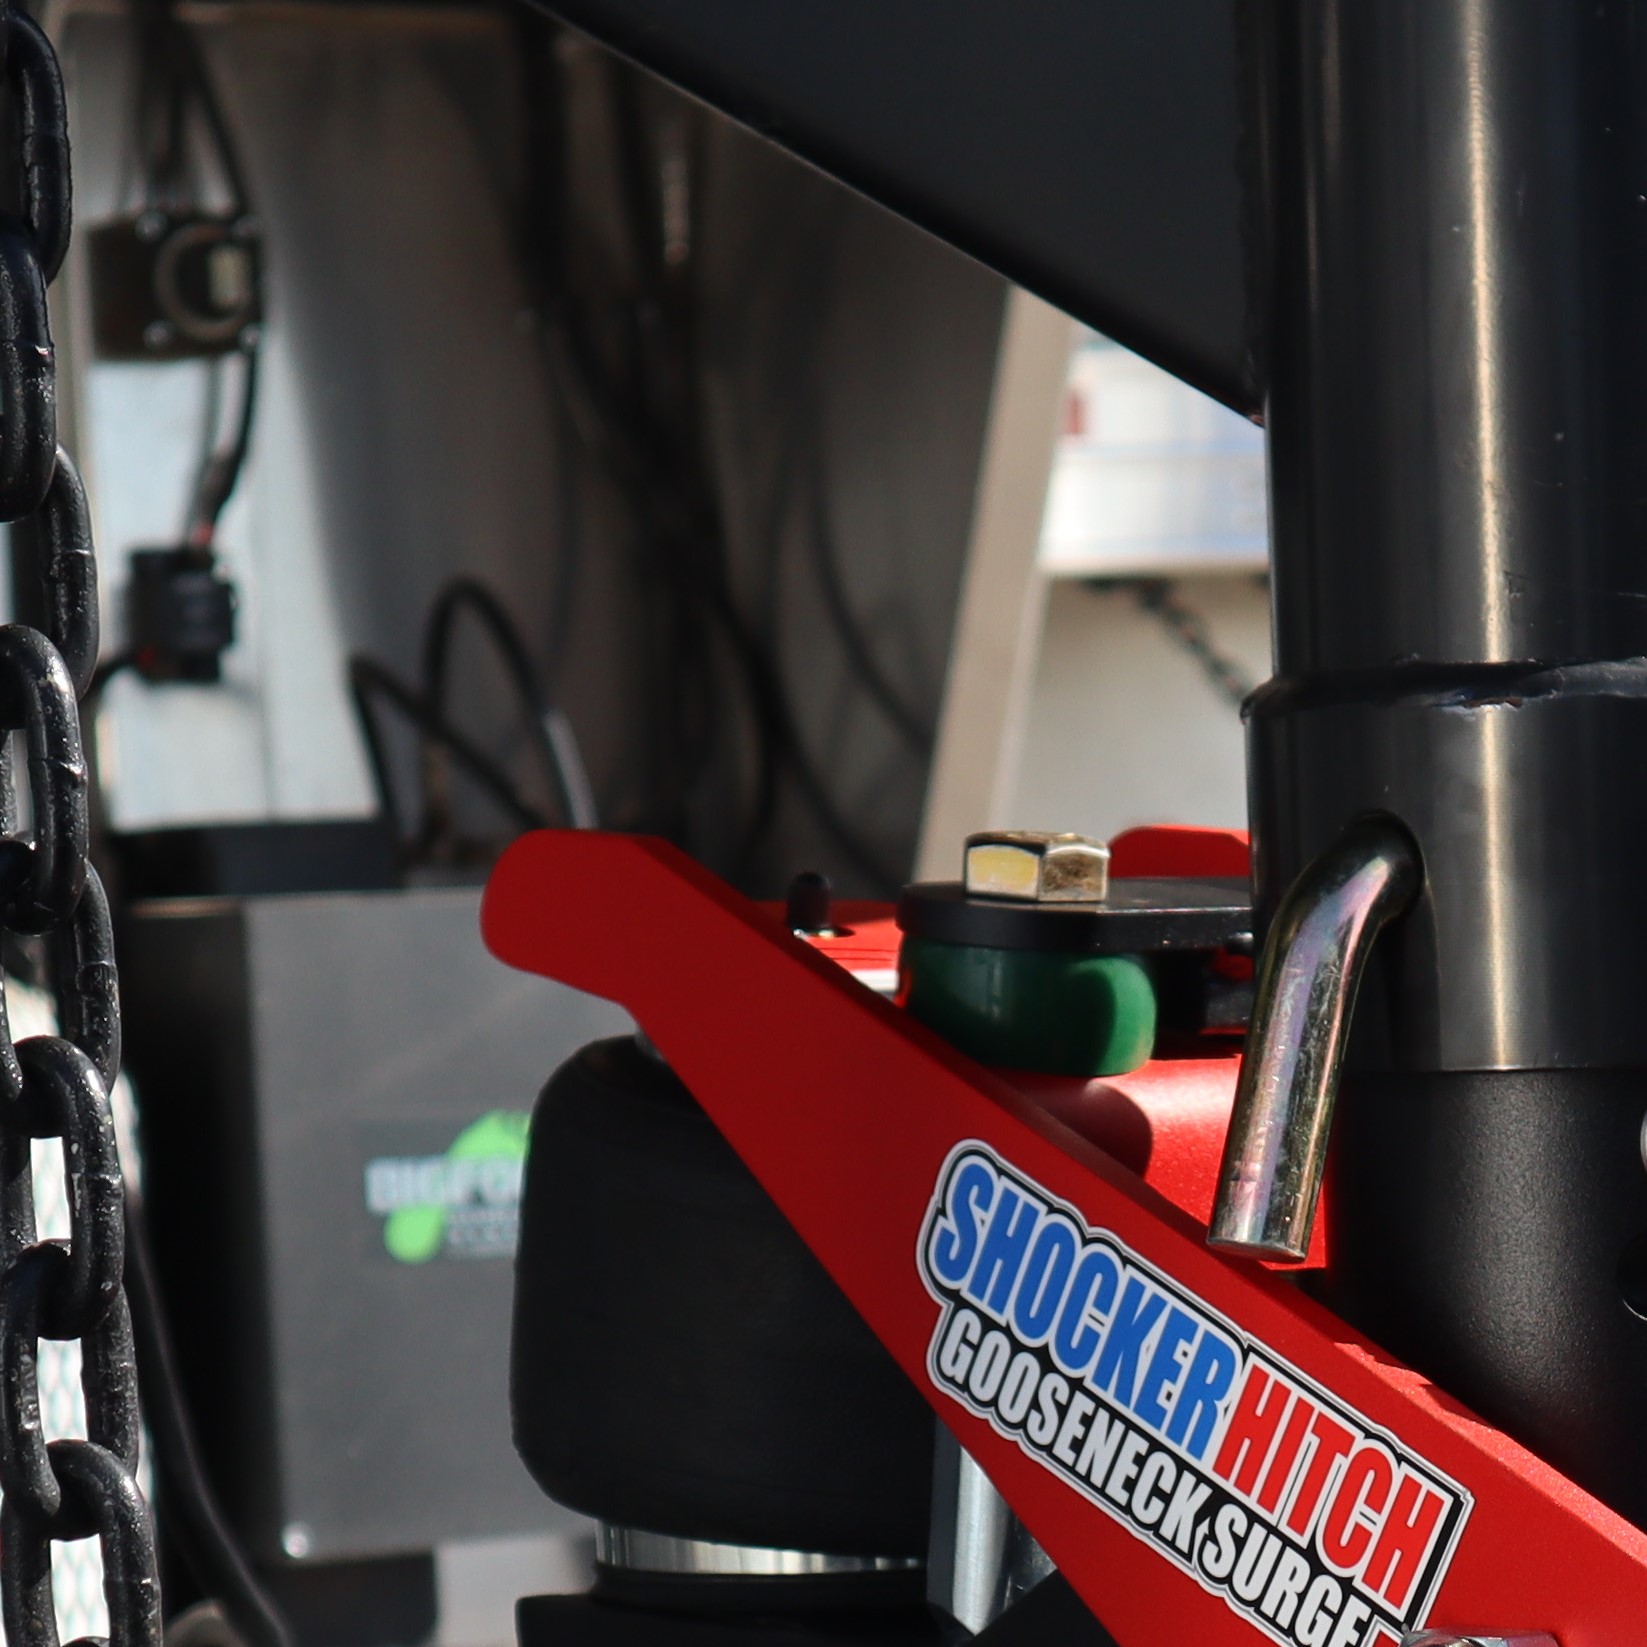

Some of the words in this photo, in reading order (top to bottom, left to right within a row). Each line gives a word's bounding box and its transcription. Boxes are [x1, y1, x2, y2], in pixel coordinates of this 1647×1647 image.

[934, 1156, 1240, 1461] SHOCKER
[1212, 1364, 1446, 1609] HITCH
[940, 1307, 1212, 1555] GOOSENECK
